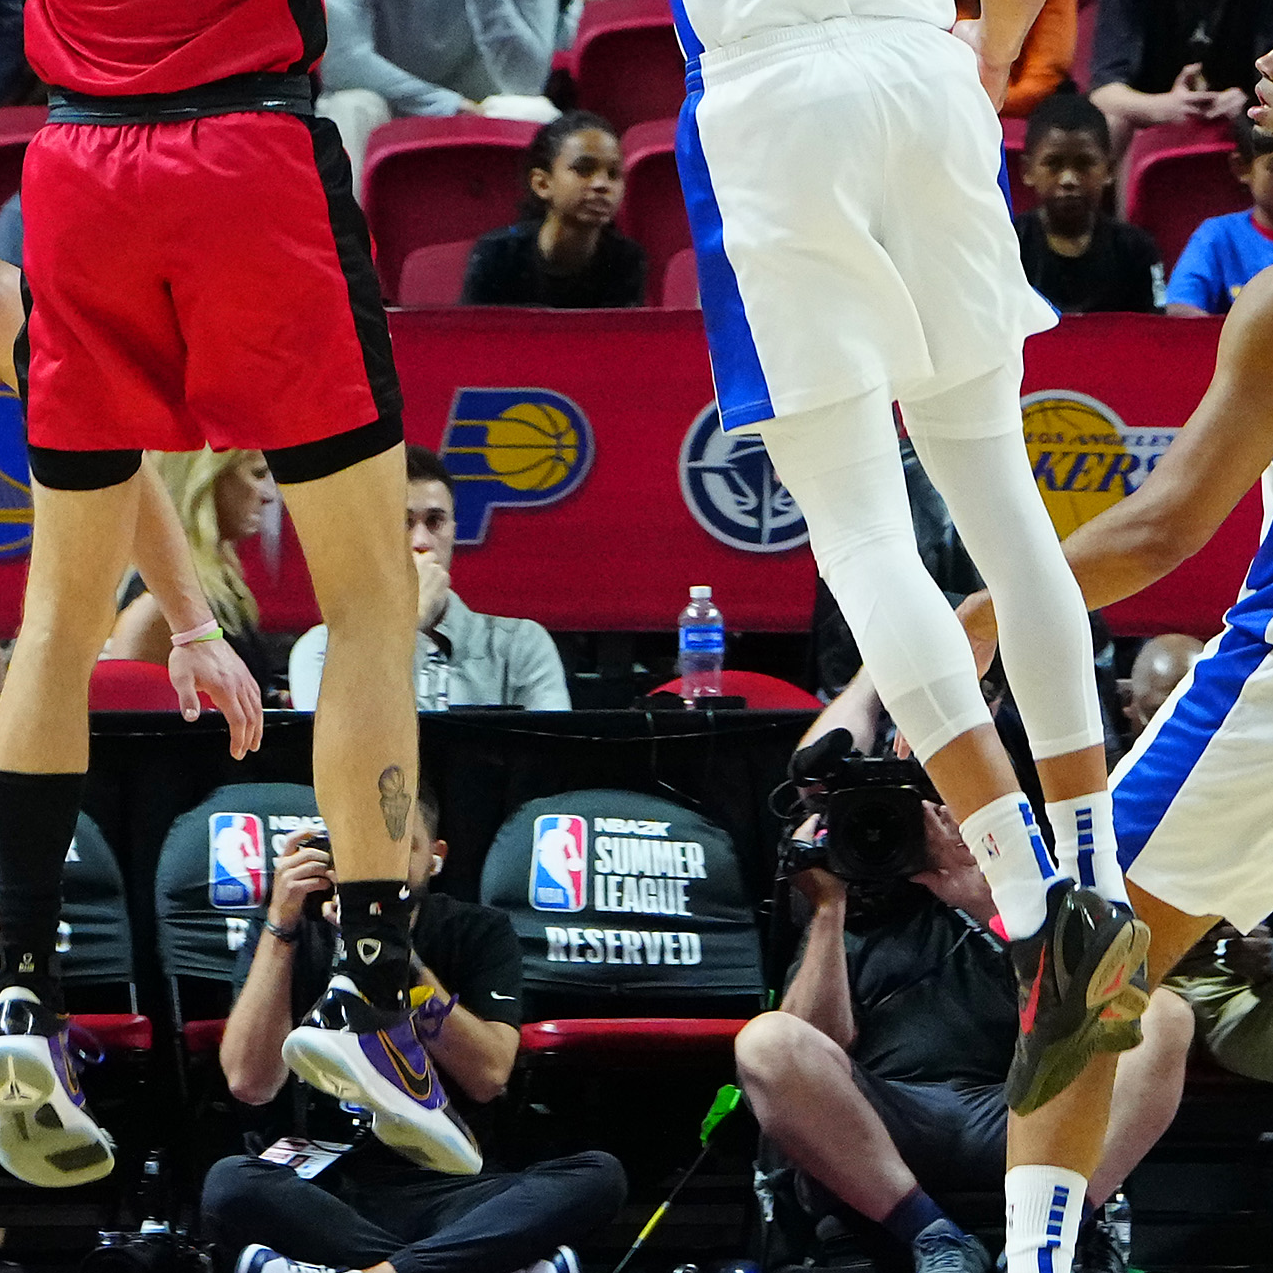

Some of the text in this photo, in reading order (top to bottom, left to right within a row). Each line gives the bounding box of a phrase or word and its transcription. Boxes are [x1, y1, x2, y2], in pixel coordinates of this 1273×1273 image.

[594, 836, 708, 879] SUMMER
[594, 874, 693, 917] LEAGUE
[545, 926, 703, 966] RESERVED
